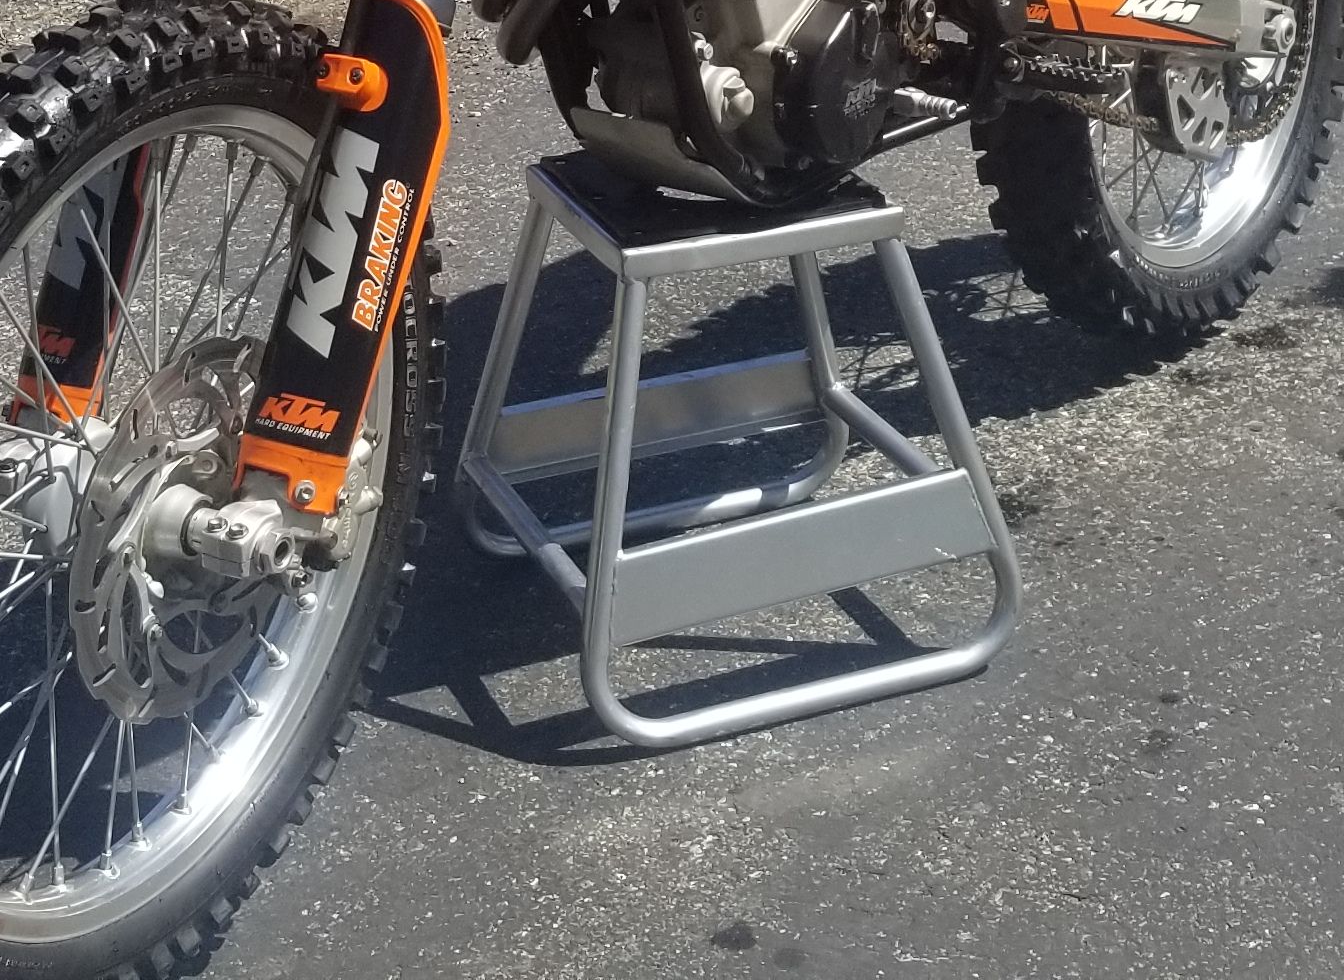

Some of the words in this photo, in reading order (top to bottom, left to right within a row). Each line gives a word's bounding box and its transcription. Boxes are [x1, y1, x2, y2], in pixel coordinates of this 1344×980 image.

[287, 128, 380, 359] KTM
[352, 179, 408, 331] BRAKING
[374, 290, 389, 332] POWER
[386, 247, 400, 286] UNDER
[397, 188, 415, 243] CONTROL
[255, 418, 276, 428] HARD
[276, 422, 331, 440] EQUIPMENT
[259, 392, 341, 432] KTM
